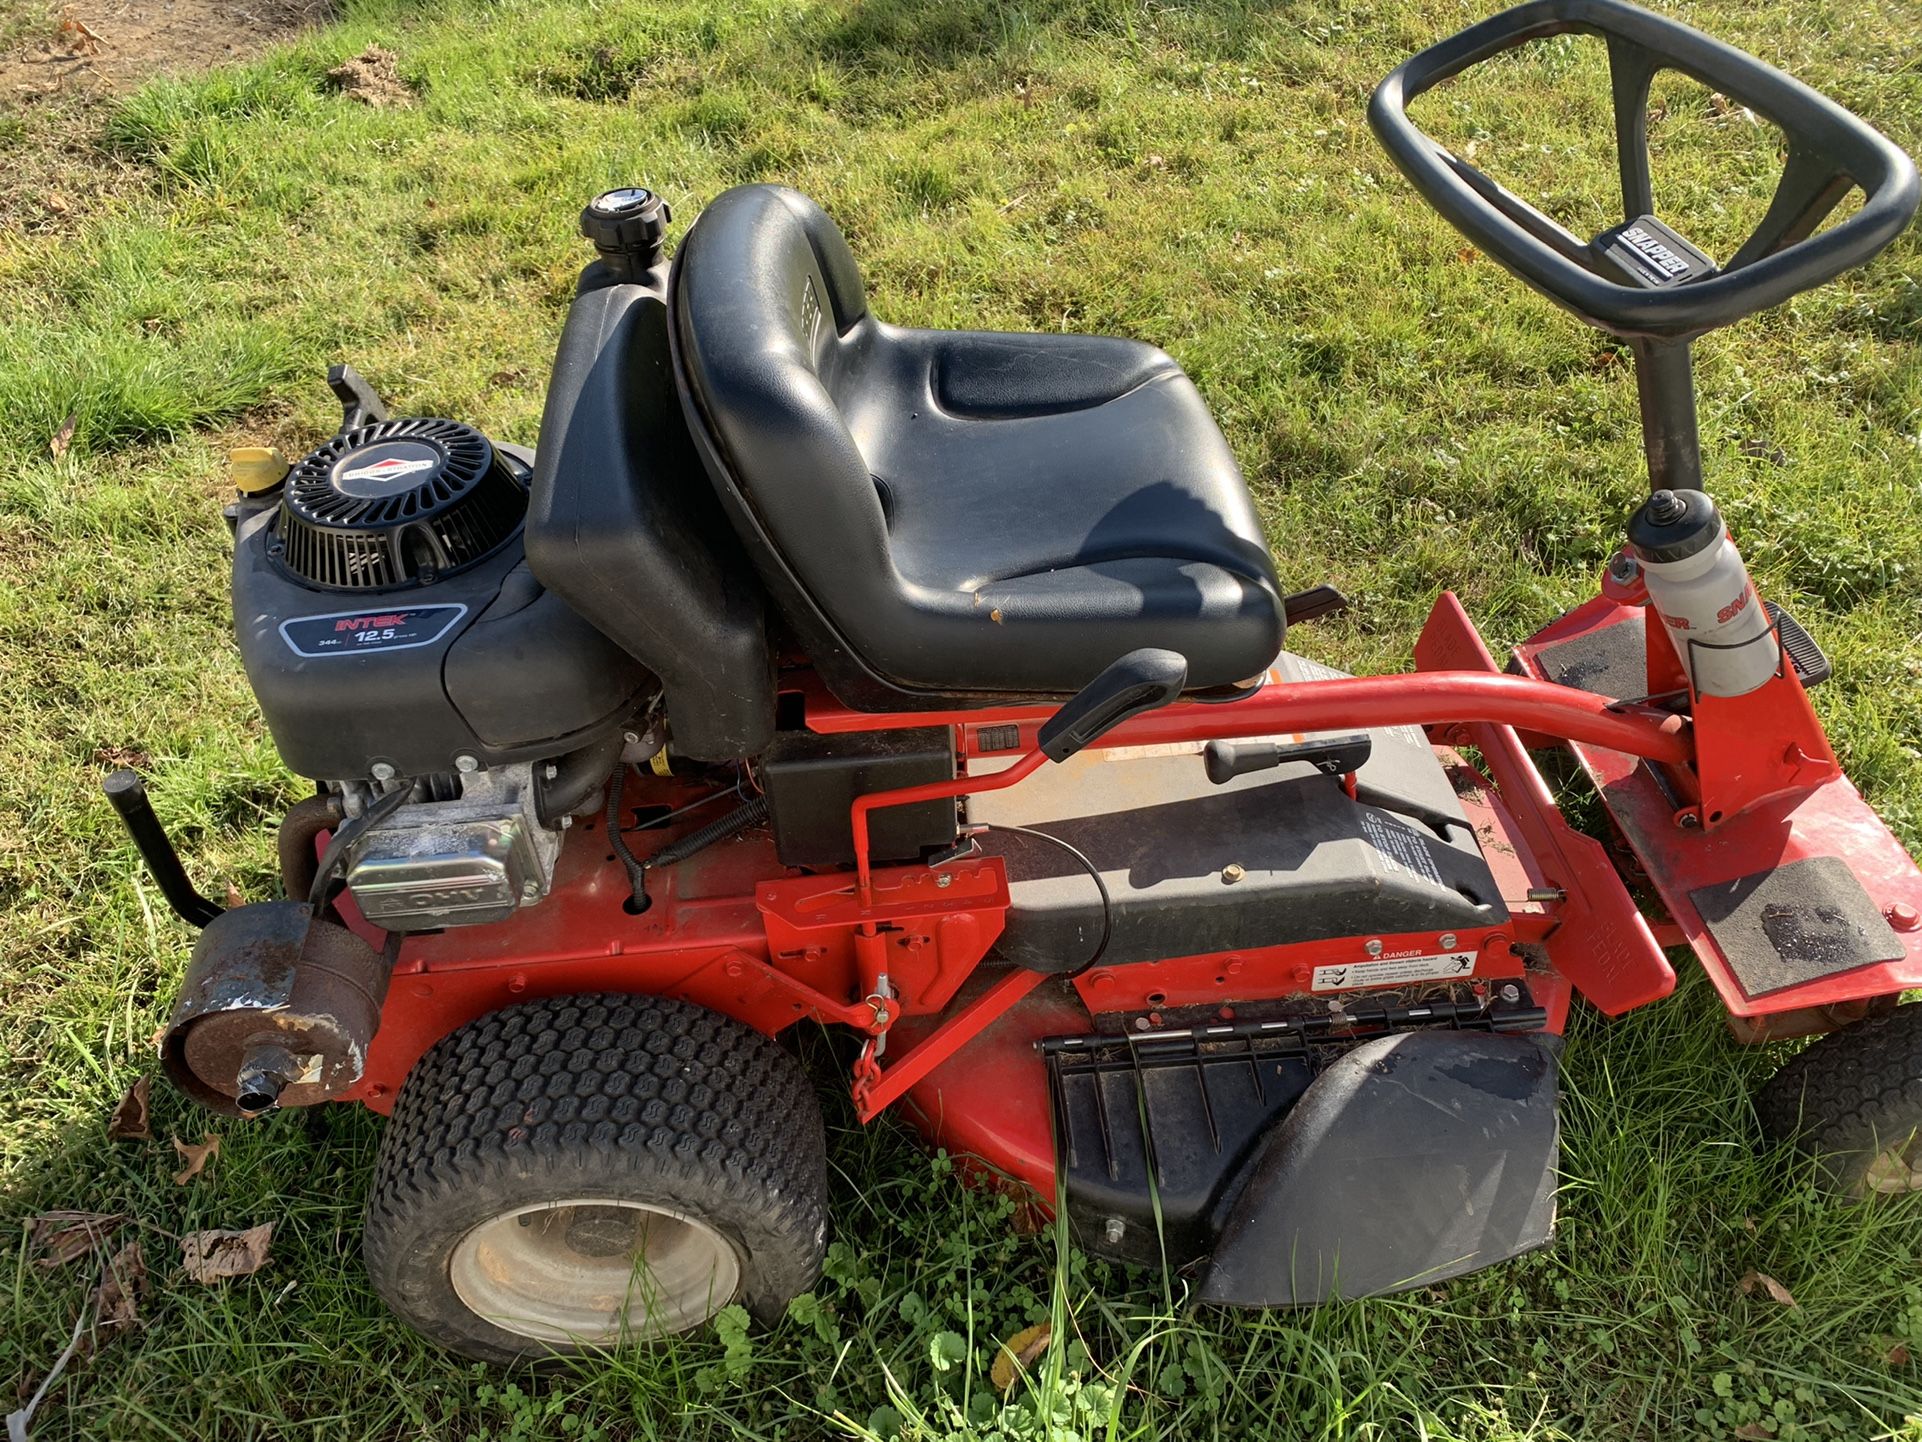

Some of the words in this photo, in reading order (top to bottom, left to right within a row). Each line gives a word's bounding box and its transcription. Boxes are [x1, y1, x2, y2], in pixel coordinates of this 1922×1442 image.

[1622, 227, 1689, 273] SNAPPER
[335, 613, 408, 631] INTEK
[354, 628, 395, 641] 12.5
[1382, 949, 1422, 960] DANGER
